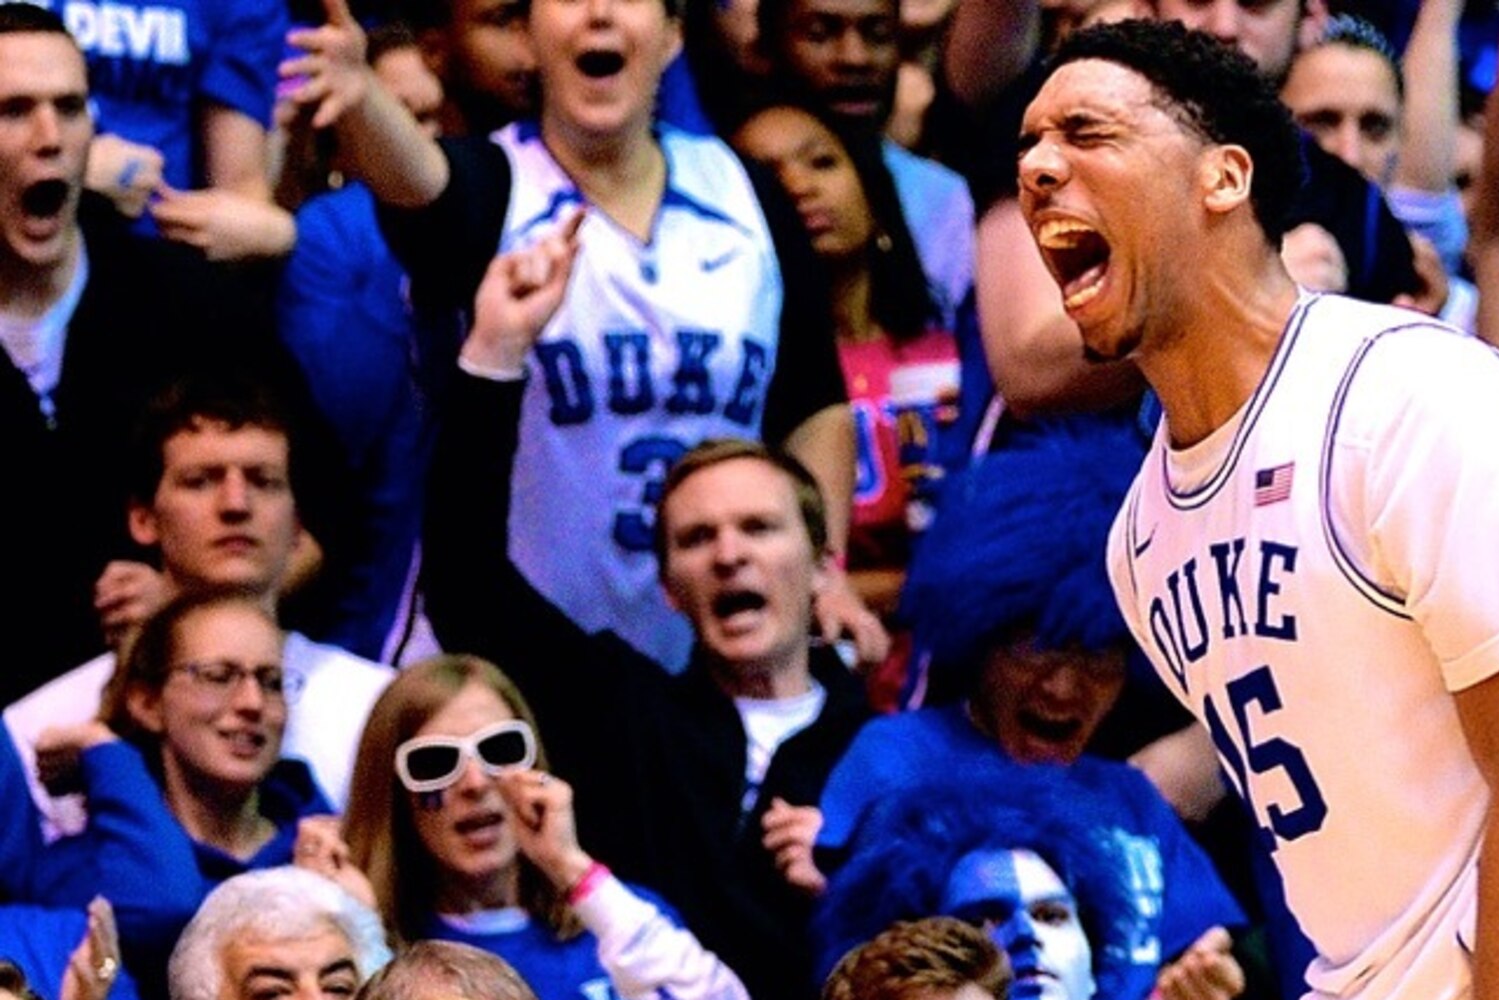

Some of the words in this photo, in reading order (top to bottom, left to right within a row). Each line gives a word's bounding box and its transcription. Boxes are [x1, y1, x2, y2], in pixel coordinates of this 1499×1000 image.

[534, 331, 766, 426] DUKE
[1150, 538, 1299, 695] DUKE
[1203, 664, 1329, 853] 15
